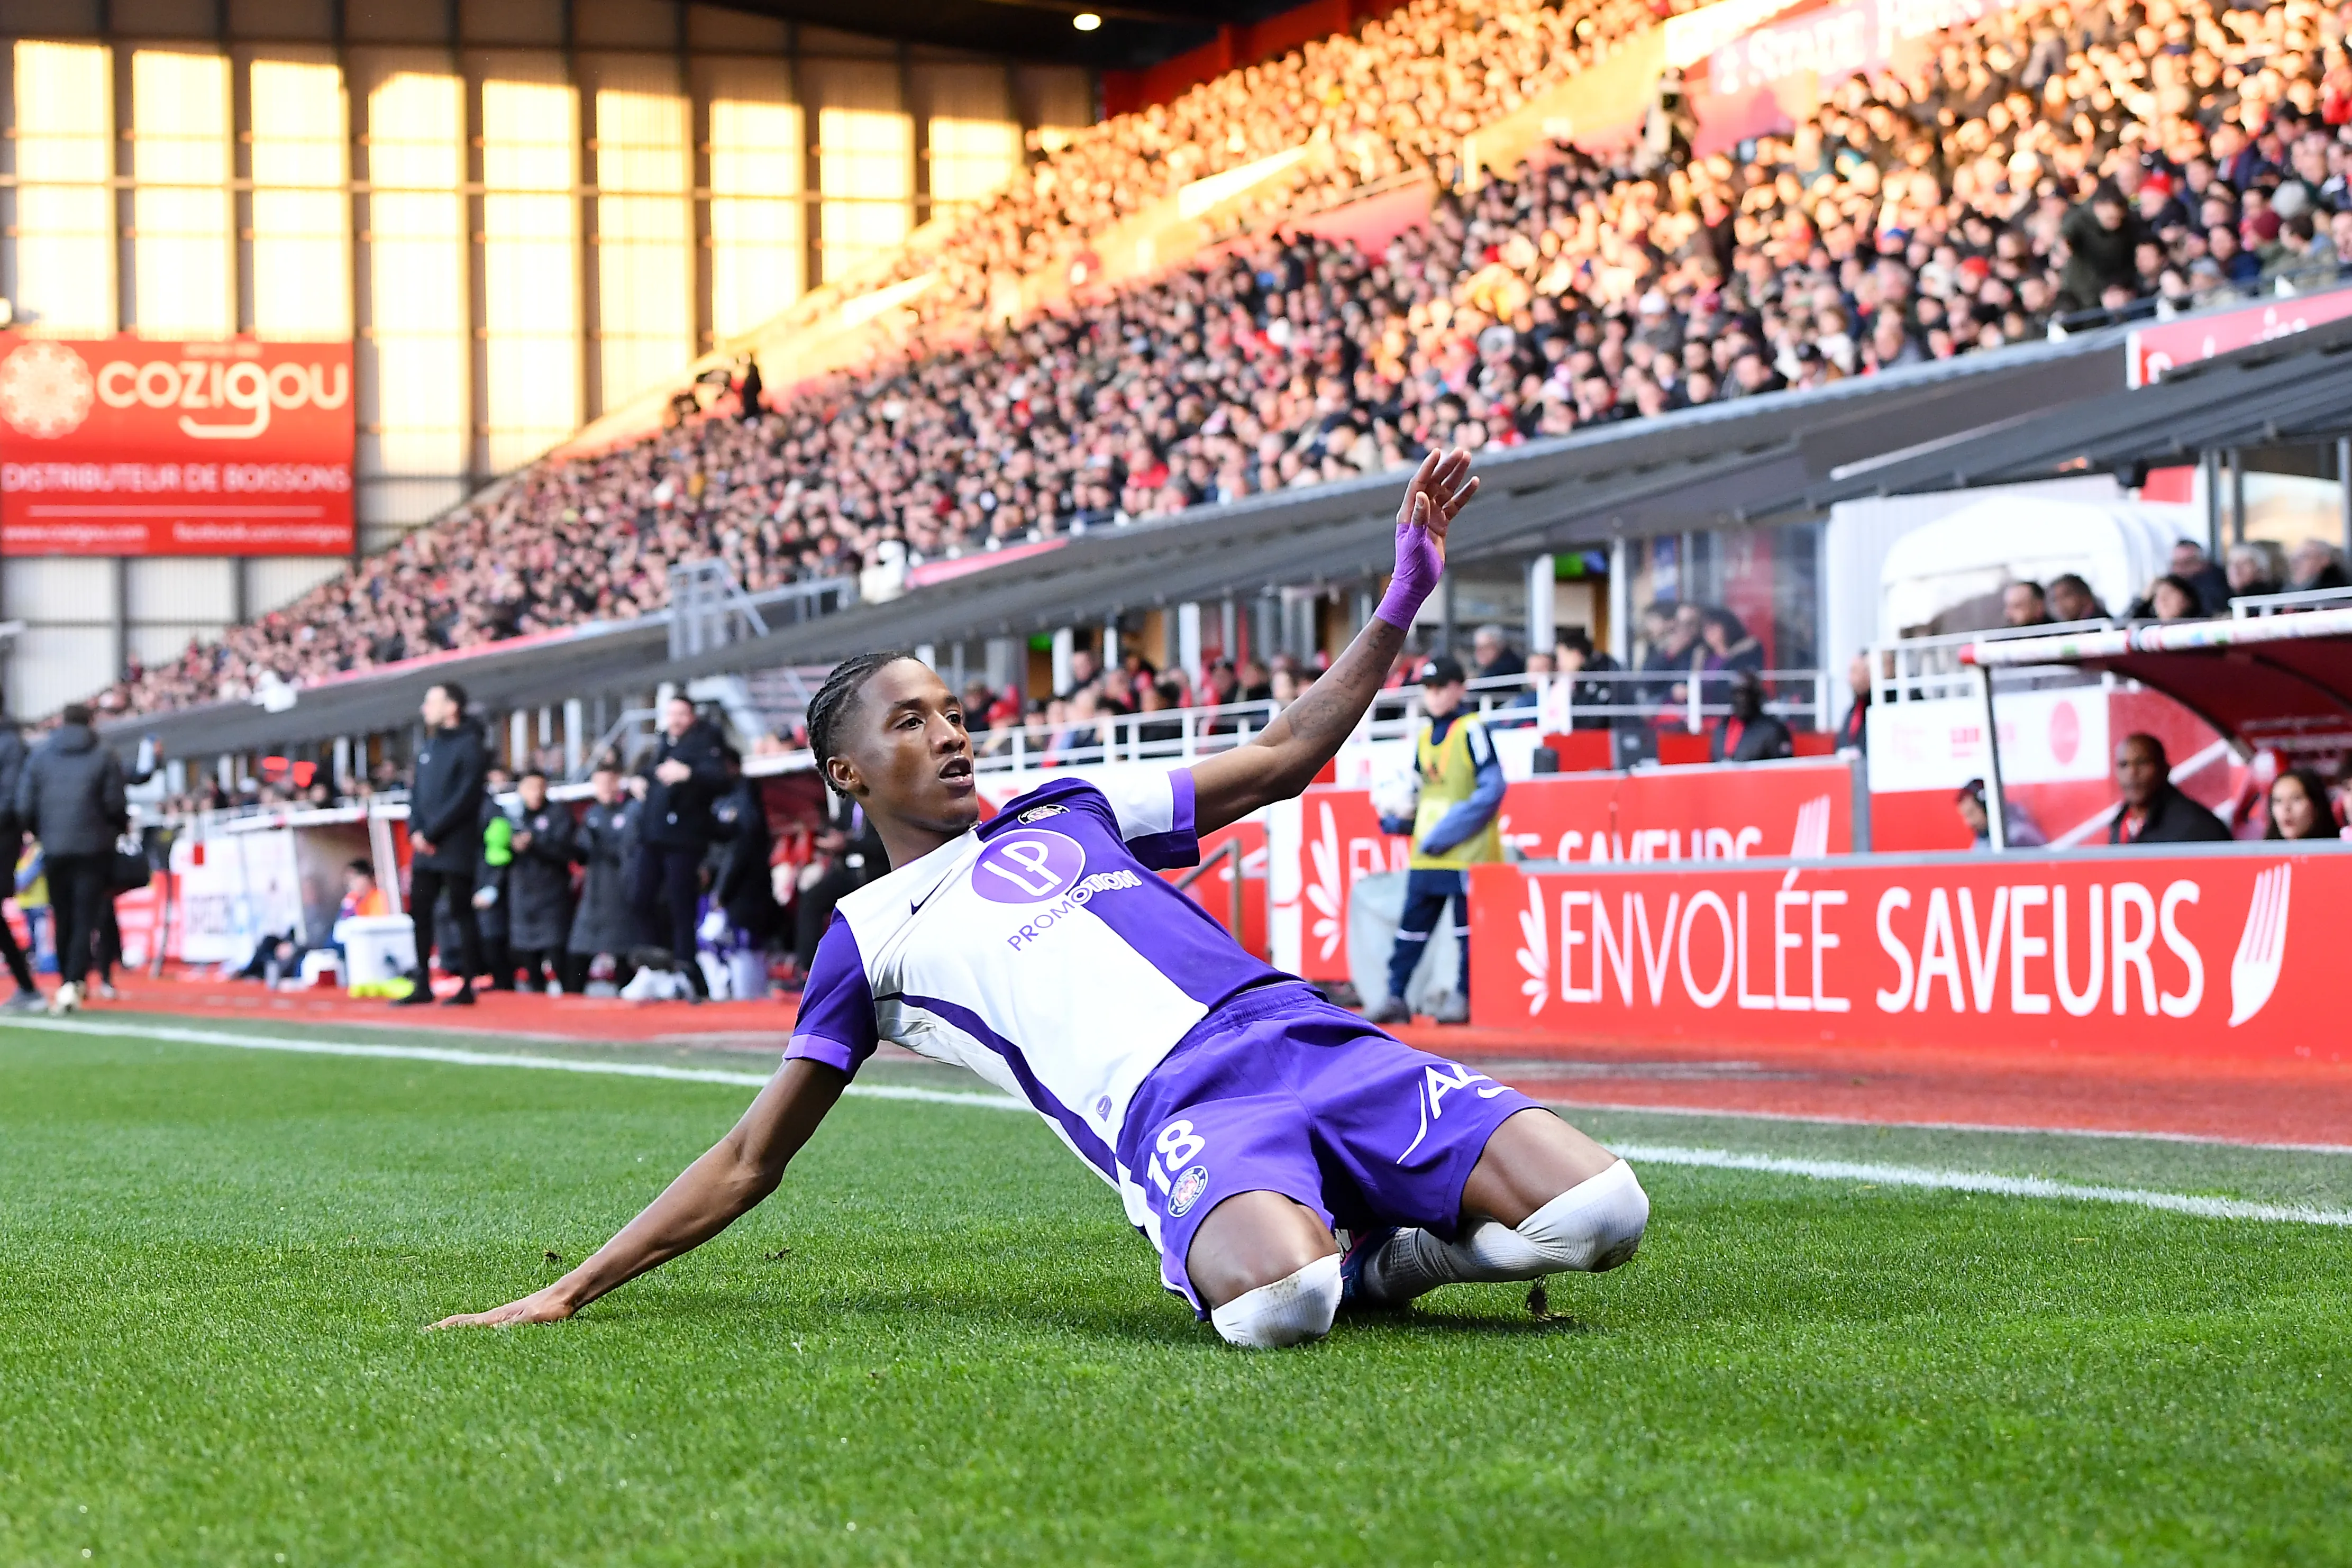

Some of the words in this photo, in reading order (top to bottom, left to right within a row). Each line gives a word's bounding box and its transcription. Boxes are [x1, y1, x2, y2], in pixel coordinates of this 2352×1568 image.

[96, 360, 349, 439] cozigou
[1007, 869, 1143, 951] PROMOTION
[1560, 867, 1849, 1013] ENVOLÉE
[1876, 880, 2205, 1018] SAVEURS
[1147, 1119, 1206, 1197] 18
